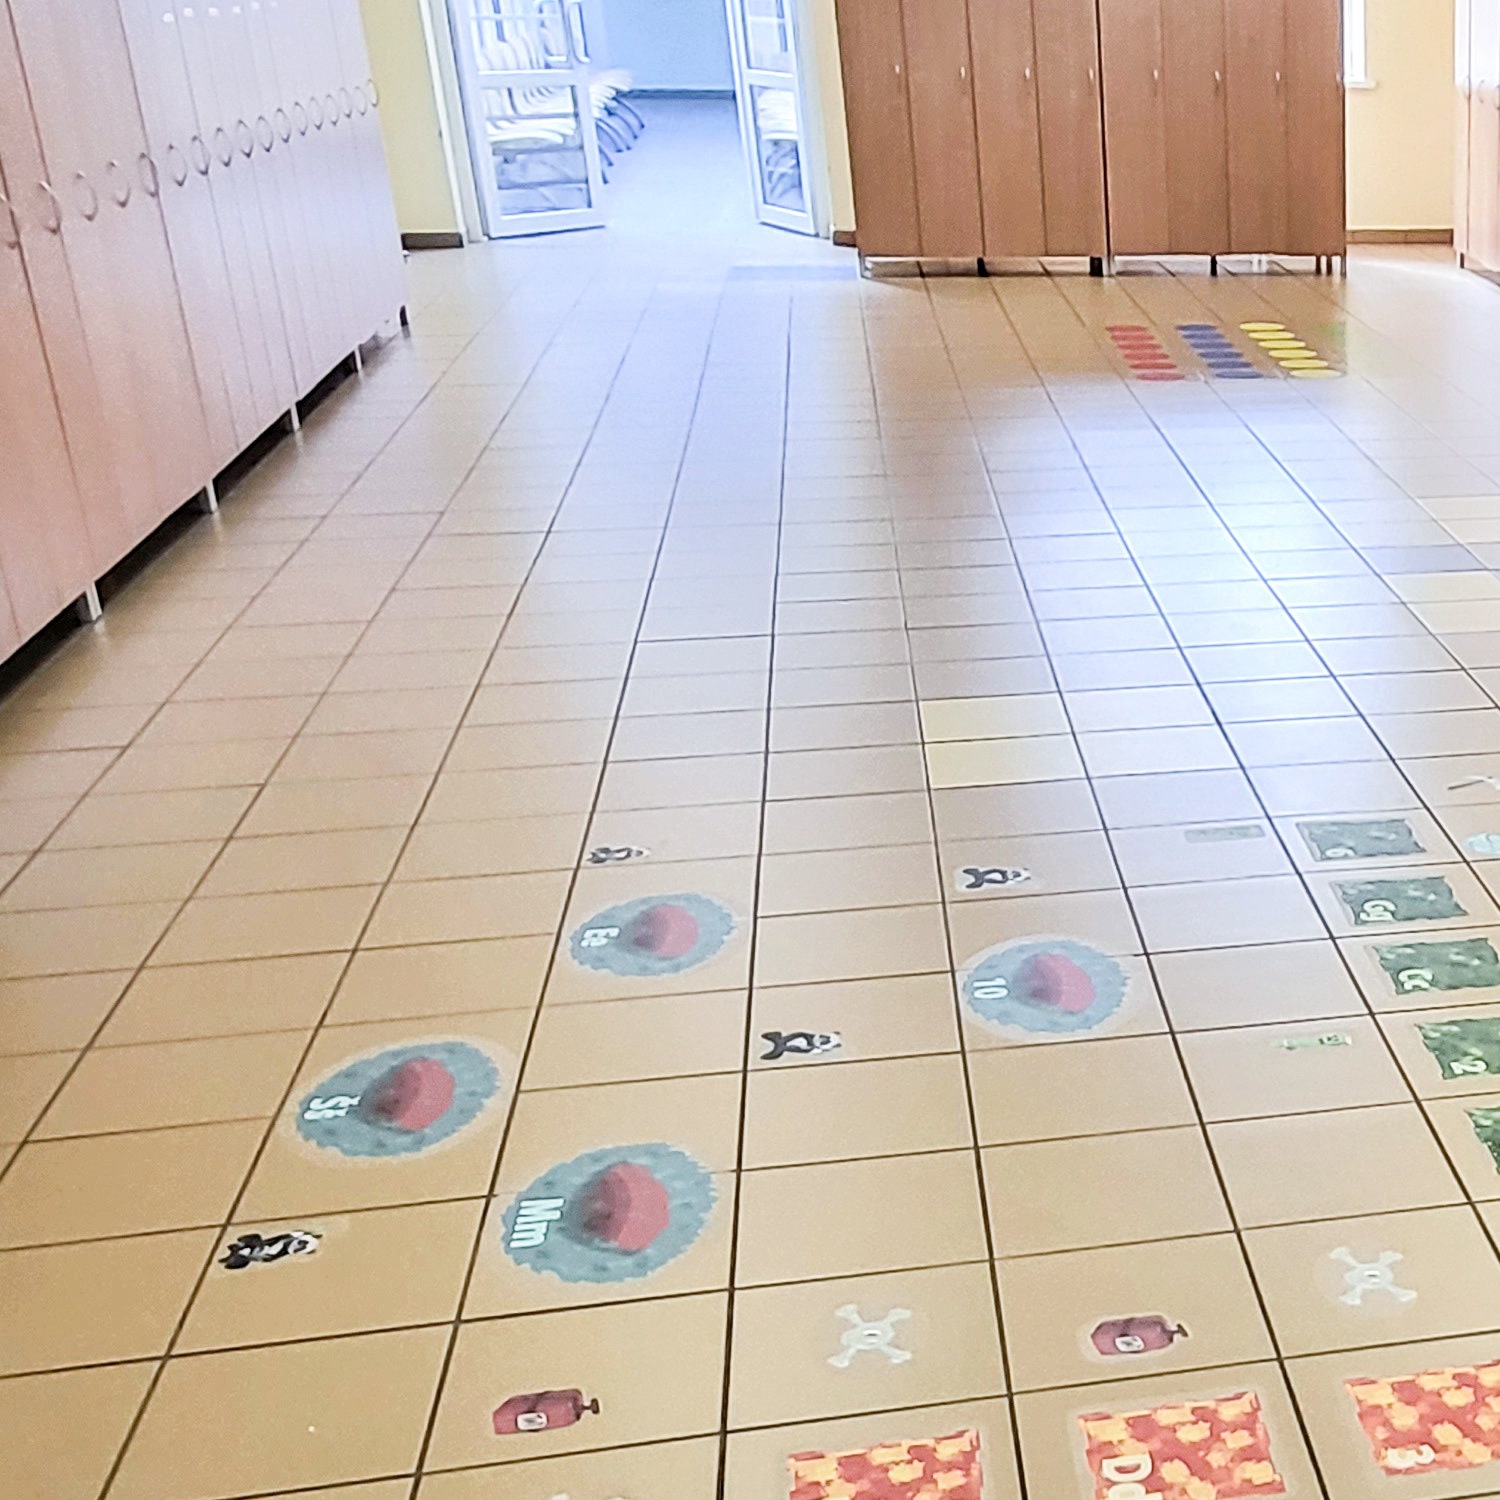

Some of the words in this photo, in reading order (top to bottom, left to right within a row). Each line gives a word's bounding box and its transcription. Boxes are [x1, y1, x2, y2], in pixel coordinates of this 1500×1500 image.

[1360, 899, 1396, 922] Gg
[973, 976, 1009, 999] 10
[1398, 968, 1433, 990] Cc
[1450, 1059, 1487, 1075] 2
[303, 1095, 361, 1120] Šš
[510, 1197, 565, 1248] Mm
[1387, 1443, 1435, 1468] 3
